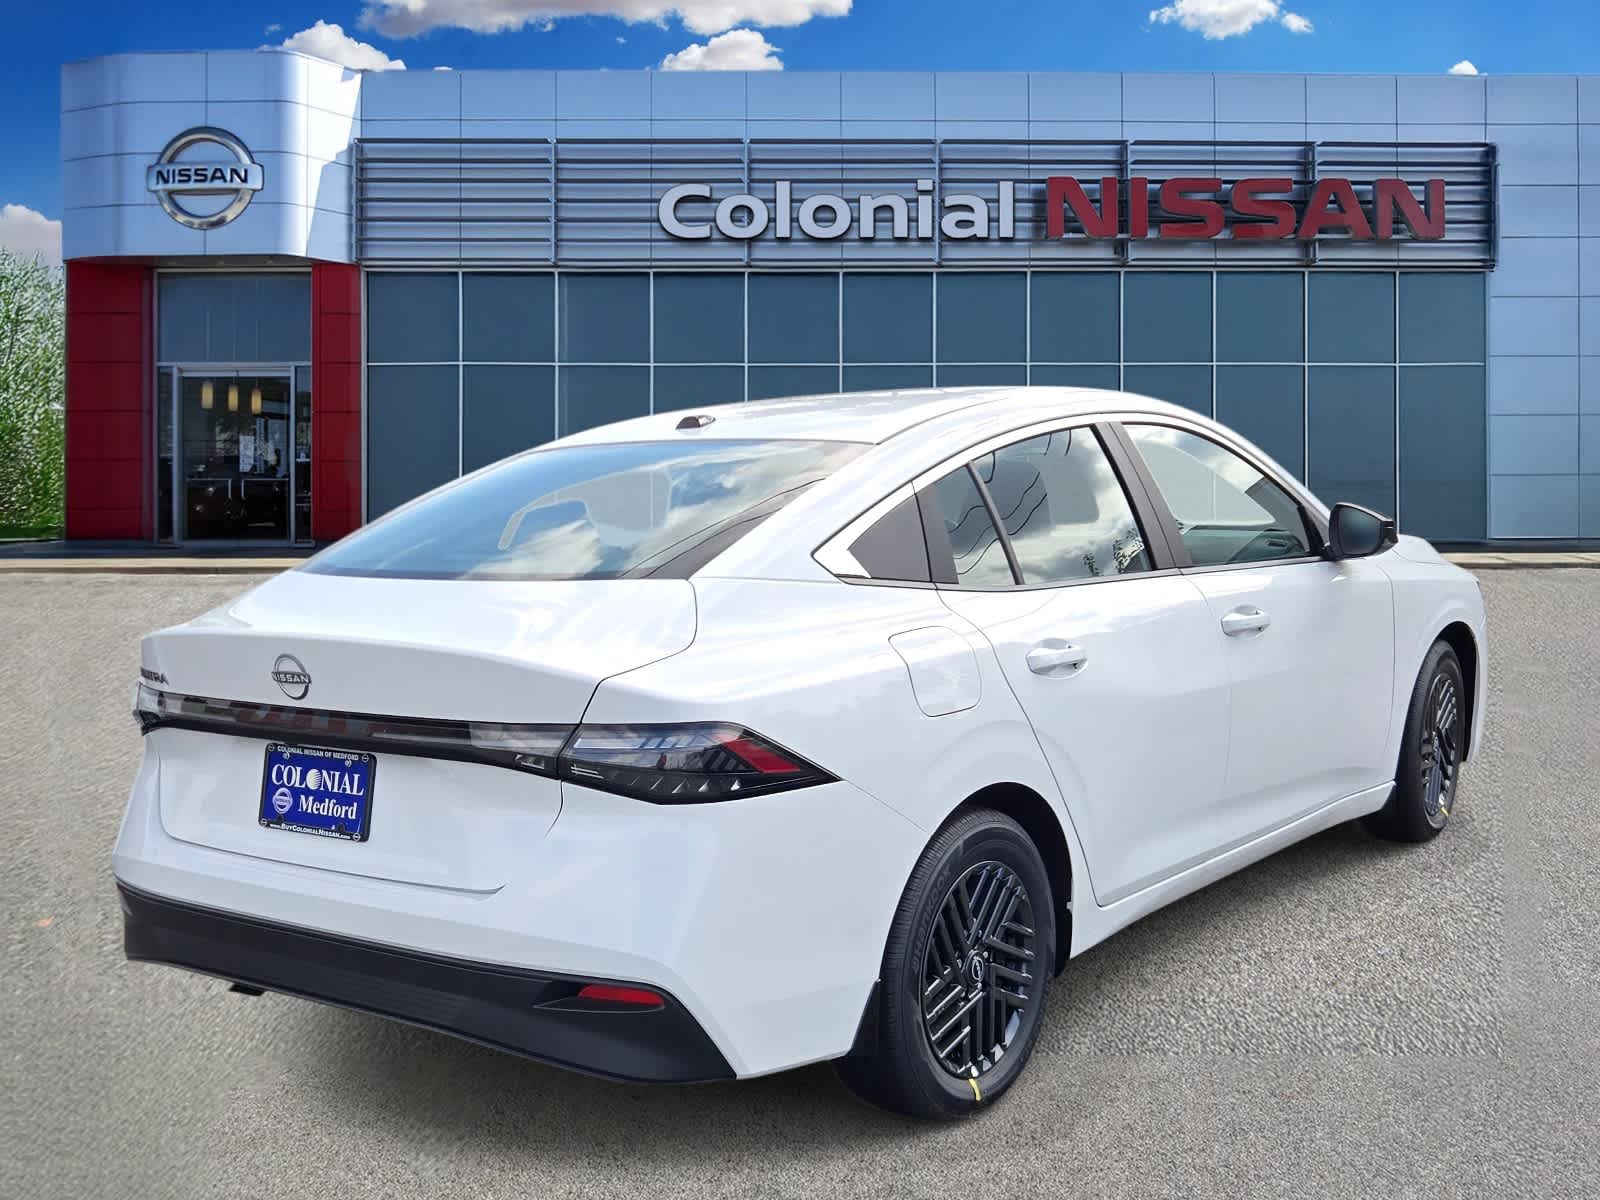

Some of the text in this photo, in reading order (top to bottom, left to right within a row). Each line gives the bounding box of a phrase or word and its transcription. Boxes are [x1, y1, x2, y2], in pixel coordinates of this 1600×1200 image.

[155, 167, 249, 185] NISSAN
[658, 176, 1447, 241] Colonial NISSAN
[271, 671, 312, 686] NISSAN
[277, 745, 303, 755] COLONIAL
[304, 749, 323, 758] NISSAN
[333, 752, 359, 761] MEDFORD
[272, 764, 364, 796] COLONIAL
[299, 795, 358, 819] Medford
